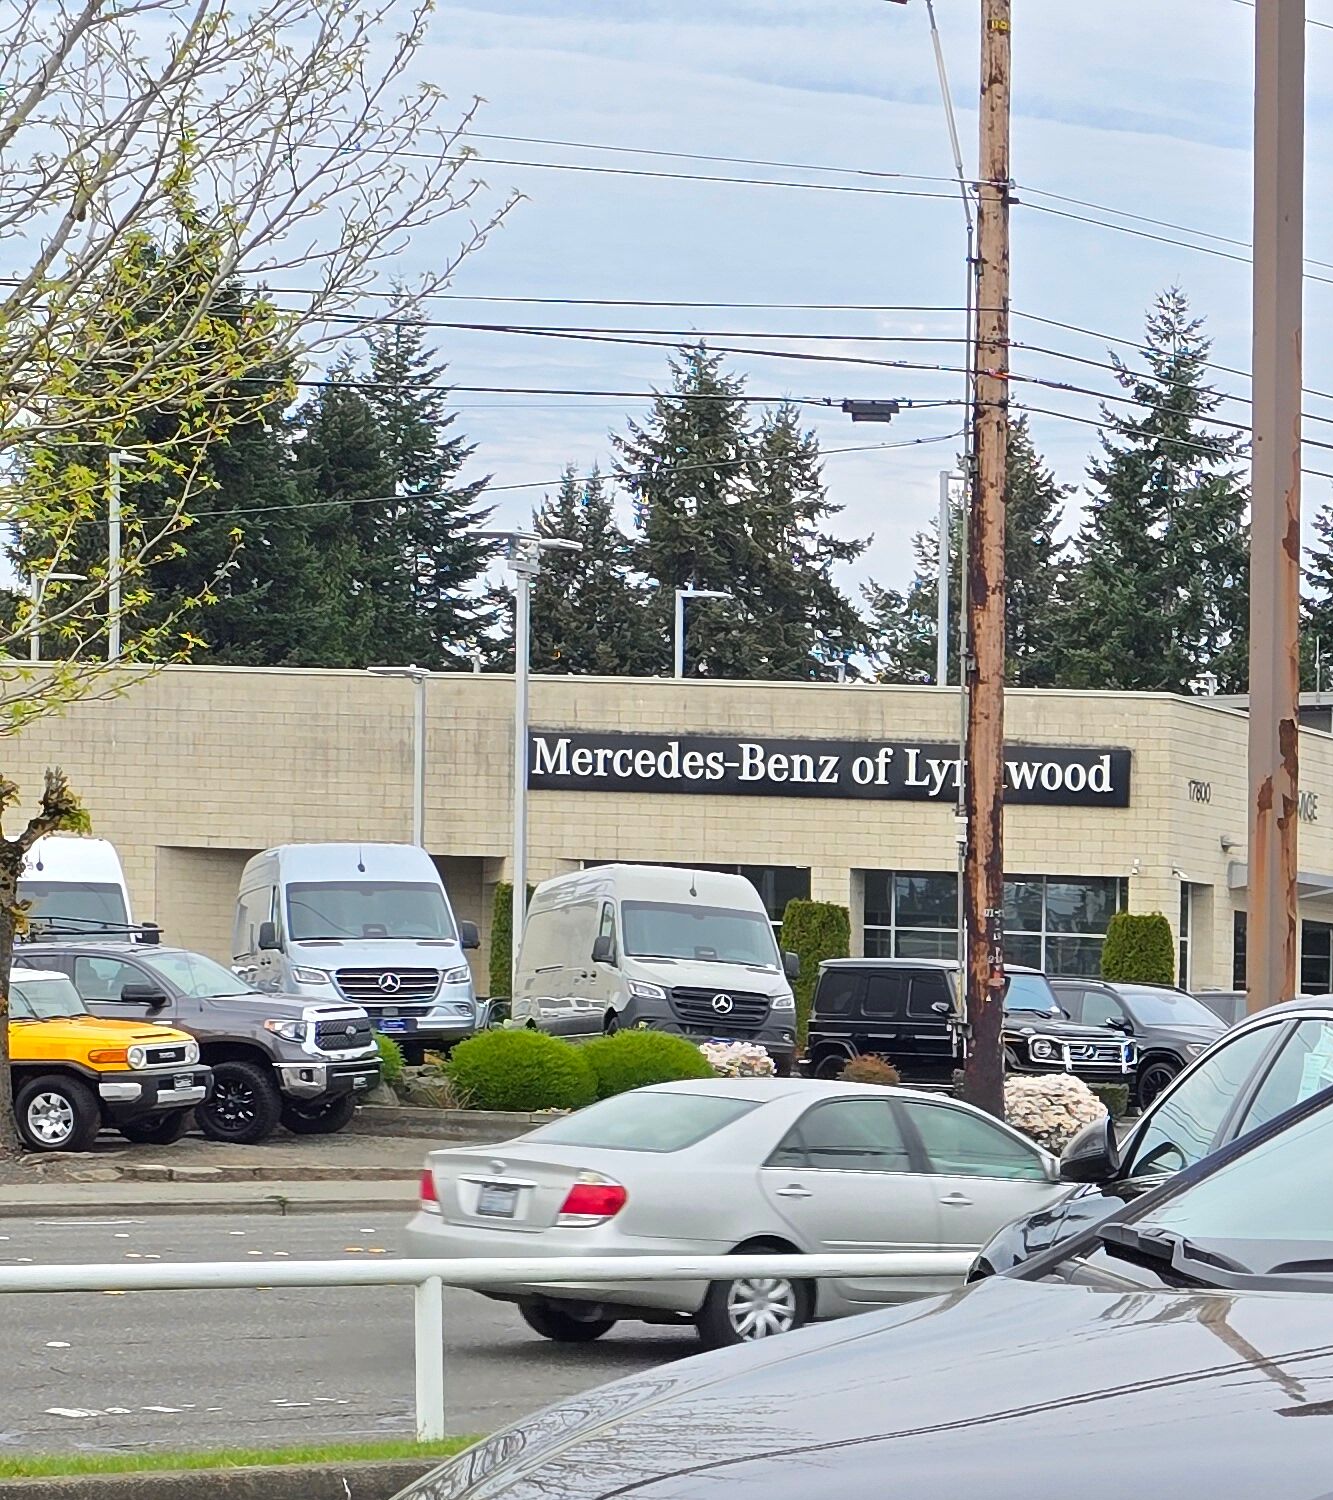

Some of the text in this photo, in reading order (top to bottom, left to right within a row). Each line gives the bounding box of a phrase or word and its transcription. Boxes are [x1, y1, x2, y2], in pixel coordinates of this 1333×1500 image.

[532, 737, 1113, 796] Mercedes-Benz of Lywood
